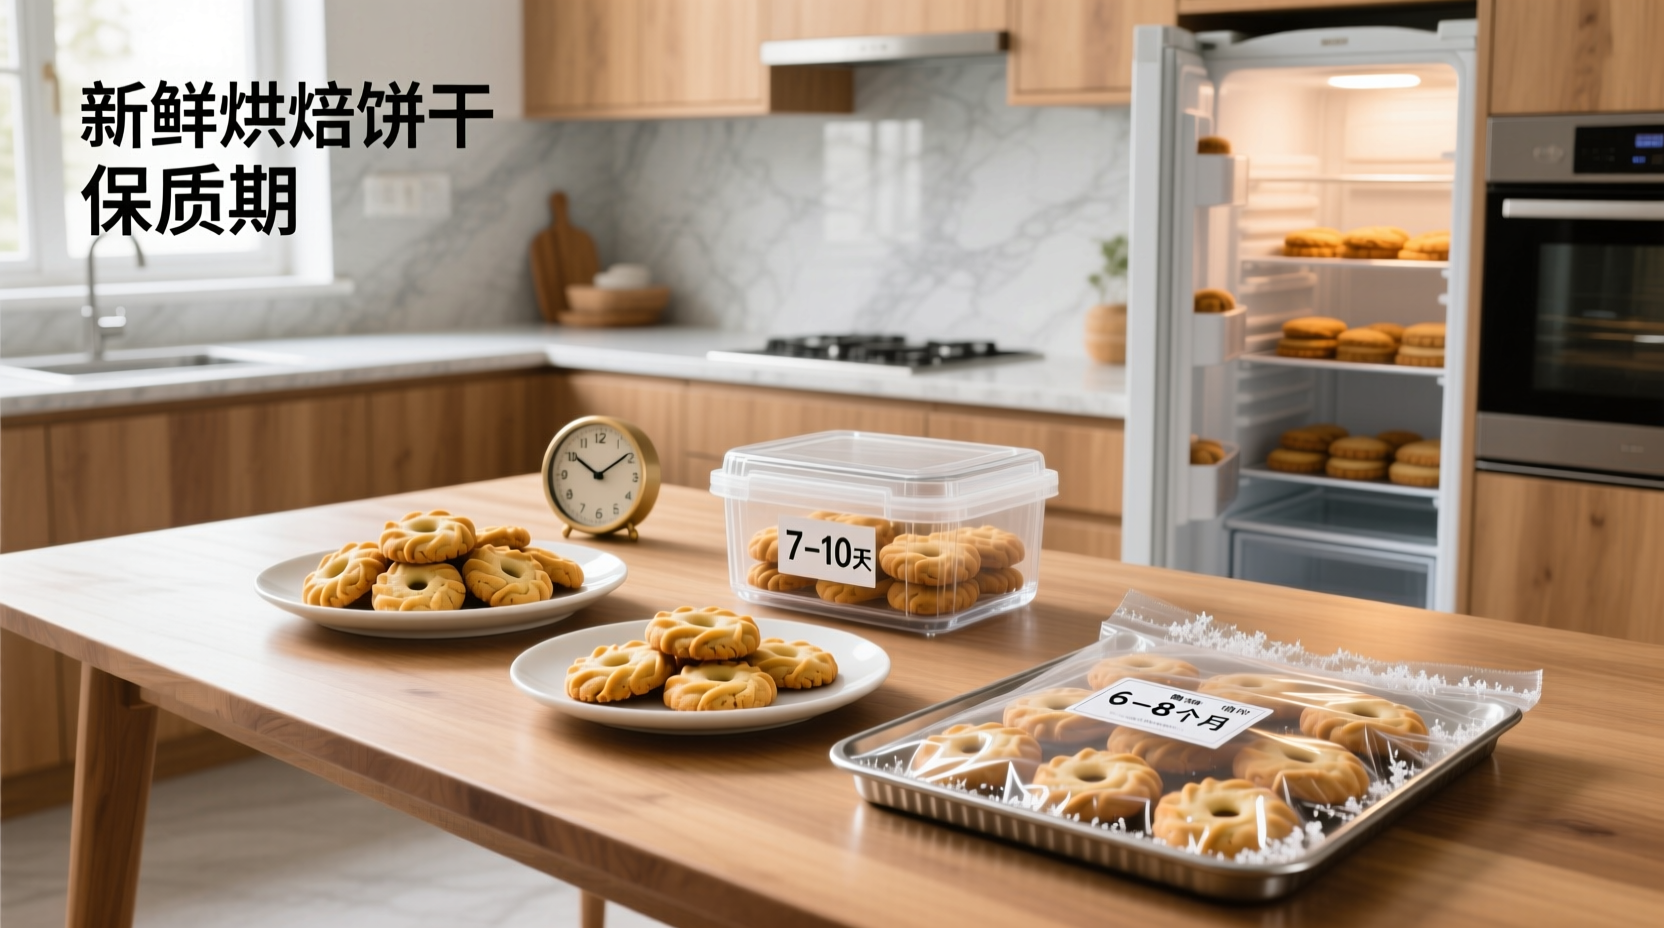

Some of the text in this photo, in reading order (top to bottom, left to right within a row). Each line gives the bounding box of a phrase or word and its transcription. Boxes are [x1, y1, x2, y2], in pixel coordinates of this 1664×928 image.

[595, 432, 607, 444] 12
[561, 469, 568, 480] 9
[624, 491, 632, 500] 4
[580, 503, 586, 513] 7
[595, 508, 603, 519] 6
[786, 529, 872, 572] 7-10天
